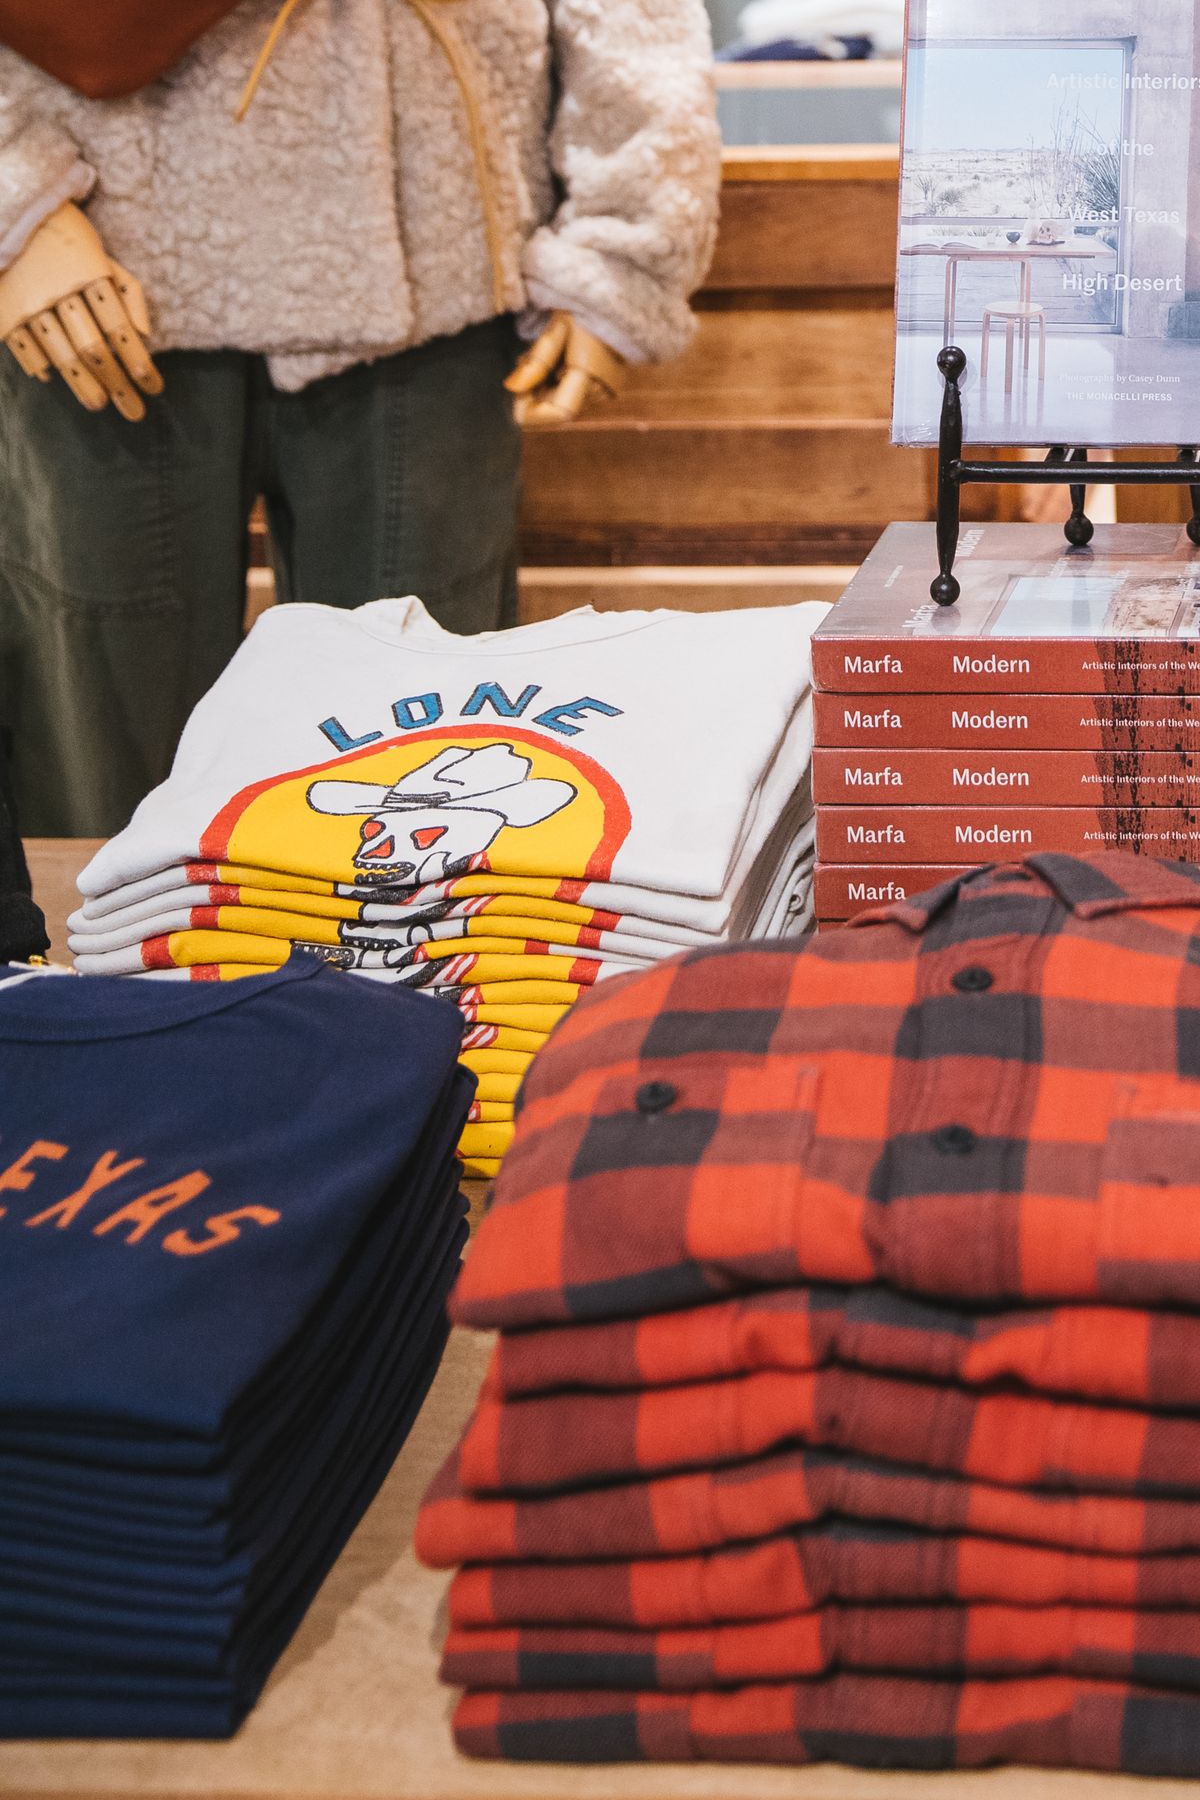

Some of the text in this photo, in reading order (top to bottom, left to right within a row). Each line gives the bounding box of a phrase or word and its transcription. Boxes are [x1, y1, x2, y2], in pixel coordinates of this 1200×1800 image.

[1046, 73, 1119, 90] Artistic
[1097, 138, 1154, 156] of the
[1068, 206, 1180, 224] West Texas
[1062, 273, 1183, 296] High Desert
[1116, 374, 1126, 385] by
[1128, 374, 1155, 385] Casey
[1156, 374, 1181, 383] Dunn
[1067, 392, 1173, 401] THE MONACELLI PRESS
[843, 654, 1031, 673] Marfa Modern
[1082, 661, 1116, 670] Artistic
[1118, 661, 1157, 670] Interiors
[1158, 661, 1169, 670] of
[1170, 661, 1186, 670] the
[317, 681, 625, 752] LONE
[843, 709, 1029, 729] Marfa Modern
[1080, 718, 1114, 728] Artistic
[1115, 718, 1154, 728] Interiors
[1156, 718, 1166, 728] of
[1168, 718, 1184, 728] the
[844, 766, 1030, 786] Marfa Modern
[1080, 774, 1115, 784] Artistic
[1116, 774, 1156, 784] Interiors
[1157, 774, 1168, 784] of
[1168, 774, 1184, 784] the
[846, 825, 1033, 844] Marfa Modern
[1083, 831, 1118, 840] Artistic
[1119, 831, 1158, 840] Interiors
[1160, 831, 1170, 840] of
[1171, 831, 1187, 840] the
[847, 881, 906, 901] Marfa
[0, 1138, 282, 1257] EXAS
